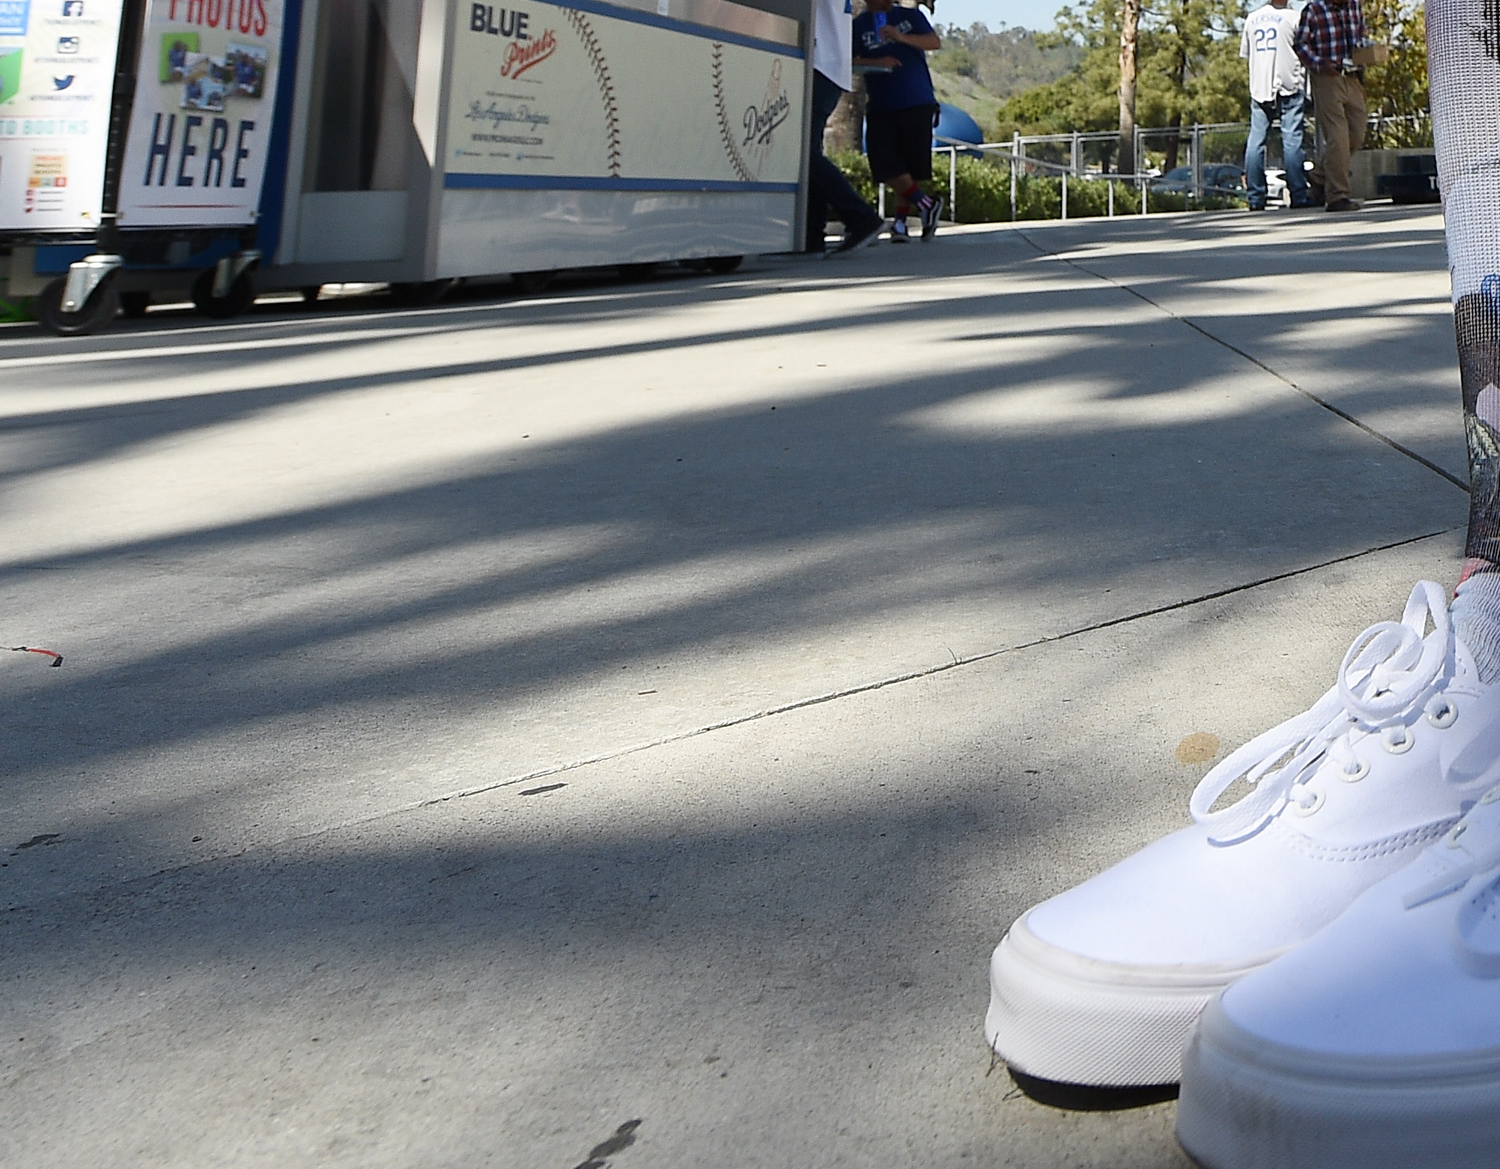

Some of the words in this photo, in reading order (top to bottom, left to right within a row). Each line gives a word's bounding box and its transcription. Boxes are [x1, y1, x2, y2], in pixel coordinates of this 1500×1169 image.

[471, 2, 530, 40] BLUE
[1253, 27, 1278, 52] 22
[742, 88, 790, 147] Dodgers
[142, 111, 257, 188] HERE
